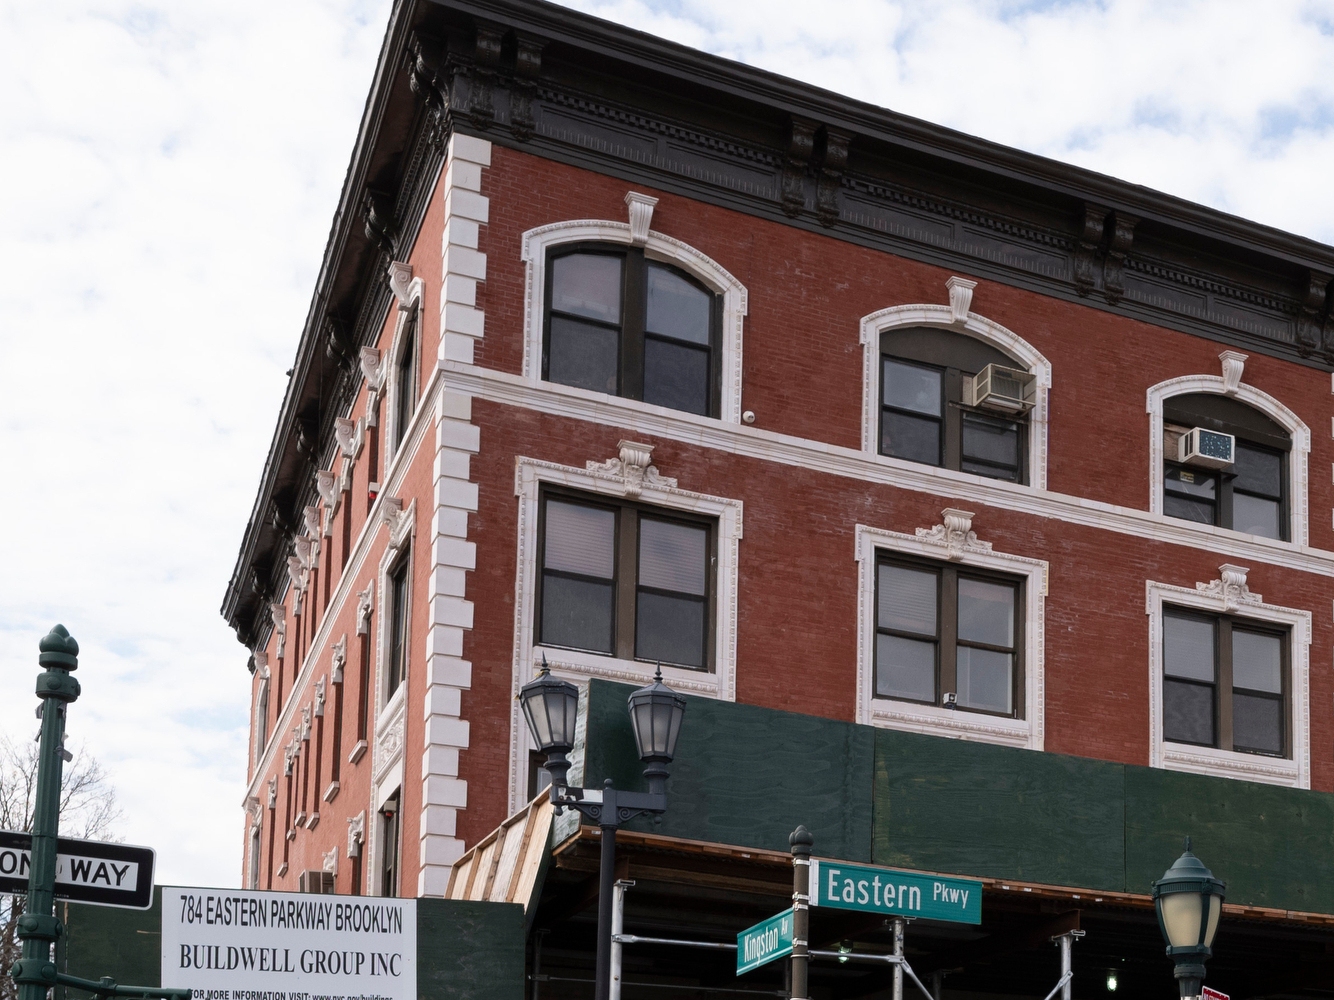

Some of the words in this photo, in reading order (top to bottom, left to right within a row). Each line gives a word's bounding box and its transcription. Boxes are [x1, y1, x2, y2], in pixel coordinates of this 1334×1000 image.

[0, 850, 31, 876] ON
[70, 858, 130, 887] WAY
[828, 869, 921, 911] Eastern
[933, 882, 969, 909] Pkwy
[180, 895, 203, 924] 784
[206, 896, 267, 928] EASTERN
[271, 900, 333, 931] PARKWAY
[335, 903, 402, 934] BROOKLYN
[179, 944, 295, 973] BUILDWELL
[300, 949, 366, 975] GROUP
[370, 952, 402, 977] INC
[743, 926, 779, 967] Kingston
[207, 990, 229, 1000] MORE
